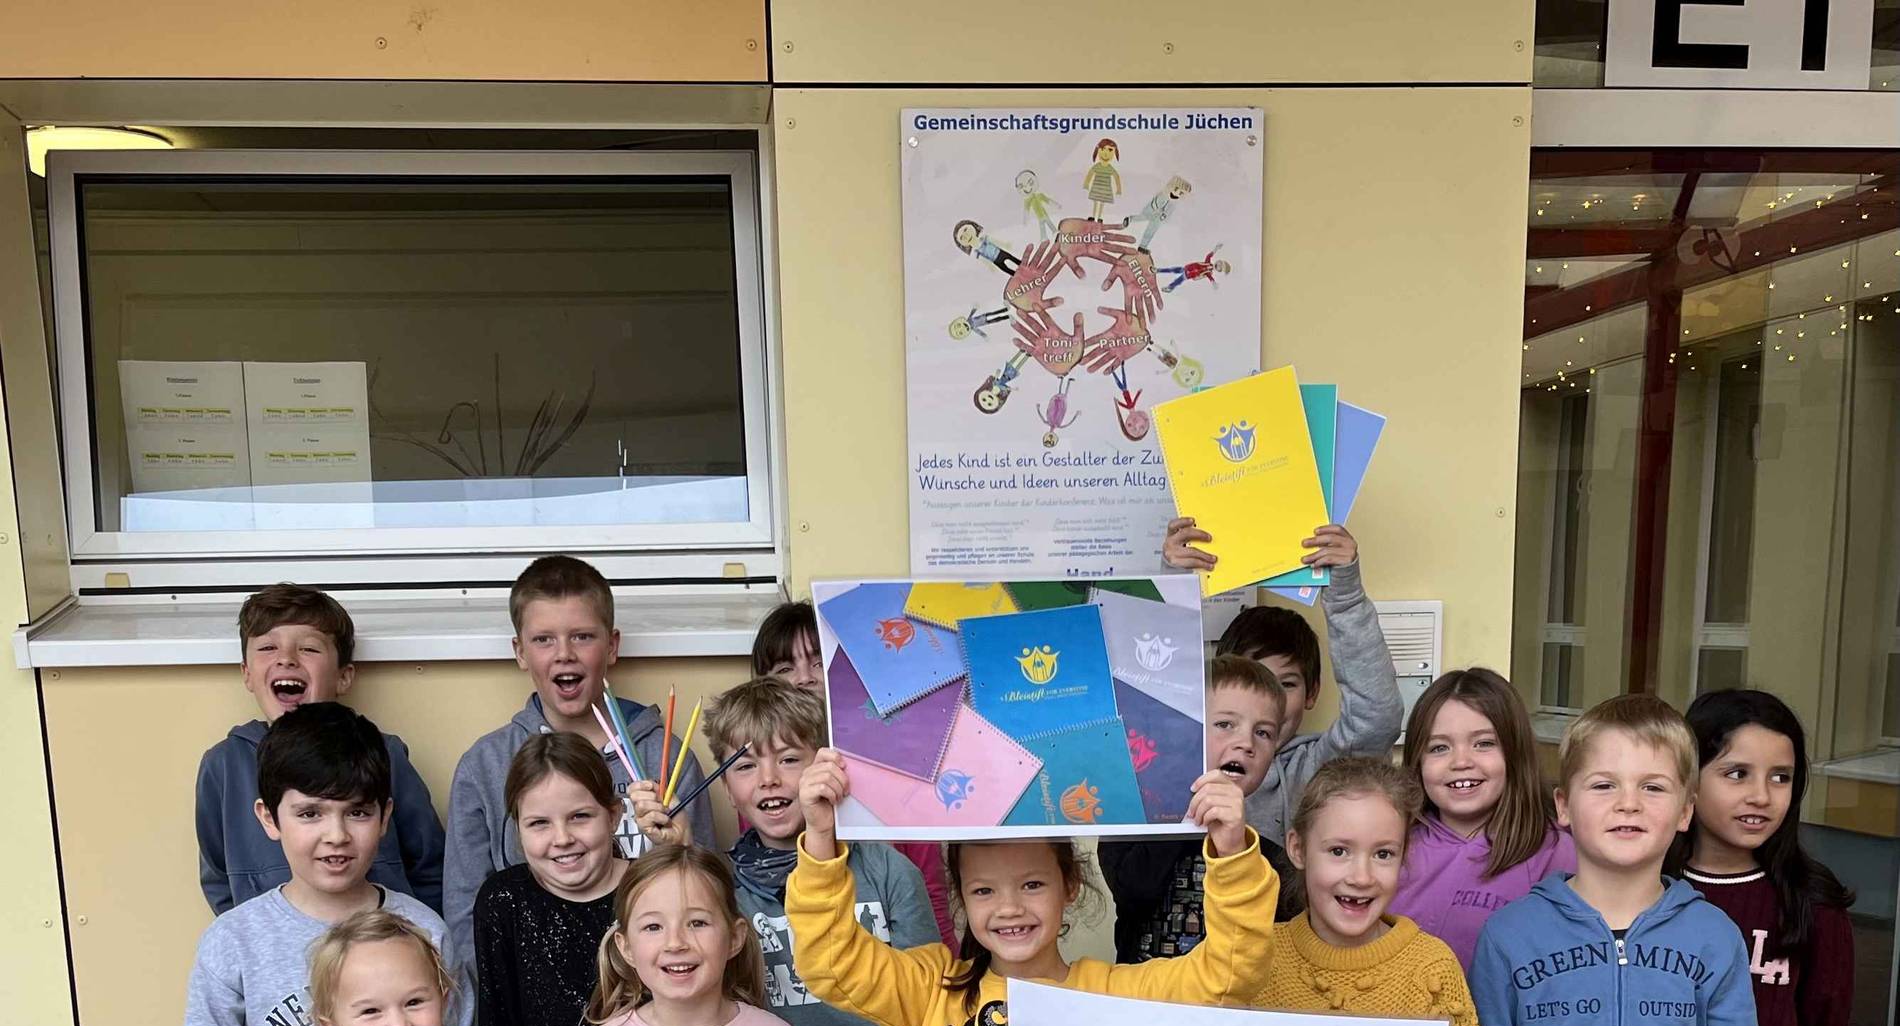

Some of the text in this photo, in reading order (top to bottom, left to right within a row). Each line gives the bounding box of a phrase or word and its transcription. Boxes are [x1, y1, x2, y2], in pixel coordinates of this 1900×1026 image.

[914, 113, 1253, 134] Gemeinschaftsgrundschule Jüchen
[1060, 232, 1106, 244] Kinder
[1005, 273, 1048, 301] Lehrer
[1127, 258, 1153, 298] Eltern
[1099, 333, 1150, 349] Partner
[1042, 351, 1074, 363] treff
[915, 449, 1165, 473] Jedes Kind ist ein Gestalter der Zu
[918, 471, 1167, 491] Wünsche und Ideen unseren Alltag
[1451, 889, 1509, 911] COLLE
[1512, 941, 1610, 990] GREEN
[1525, 998, 1697, 1020] LET'S GO OUTSID
